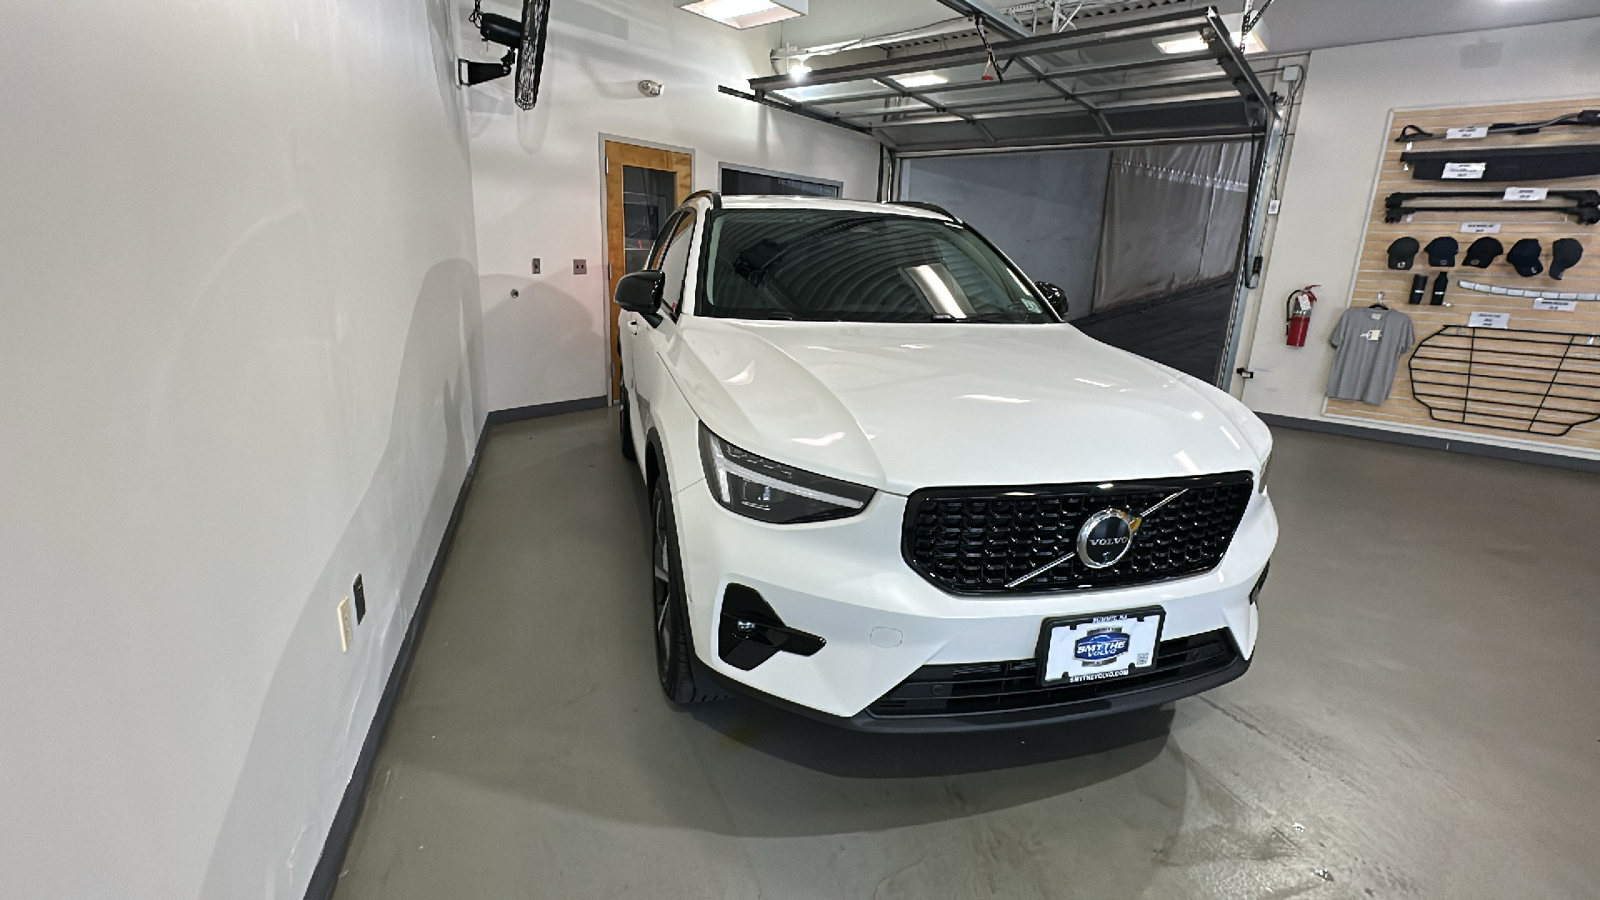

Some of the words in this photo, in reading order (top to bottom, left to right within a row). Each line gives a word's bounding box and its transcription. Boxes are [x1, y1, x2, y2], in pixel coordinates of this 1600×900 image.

[1089, 536, 1129, 546] VOLVO
[1077, 640, 1127, 654] SMYTHE
[1087, 649, 1117, 658] VOLVO
[1069, 669, 1129, 683] SMYTHEVOLVO.COM
